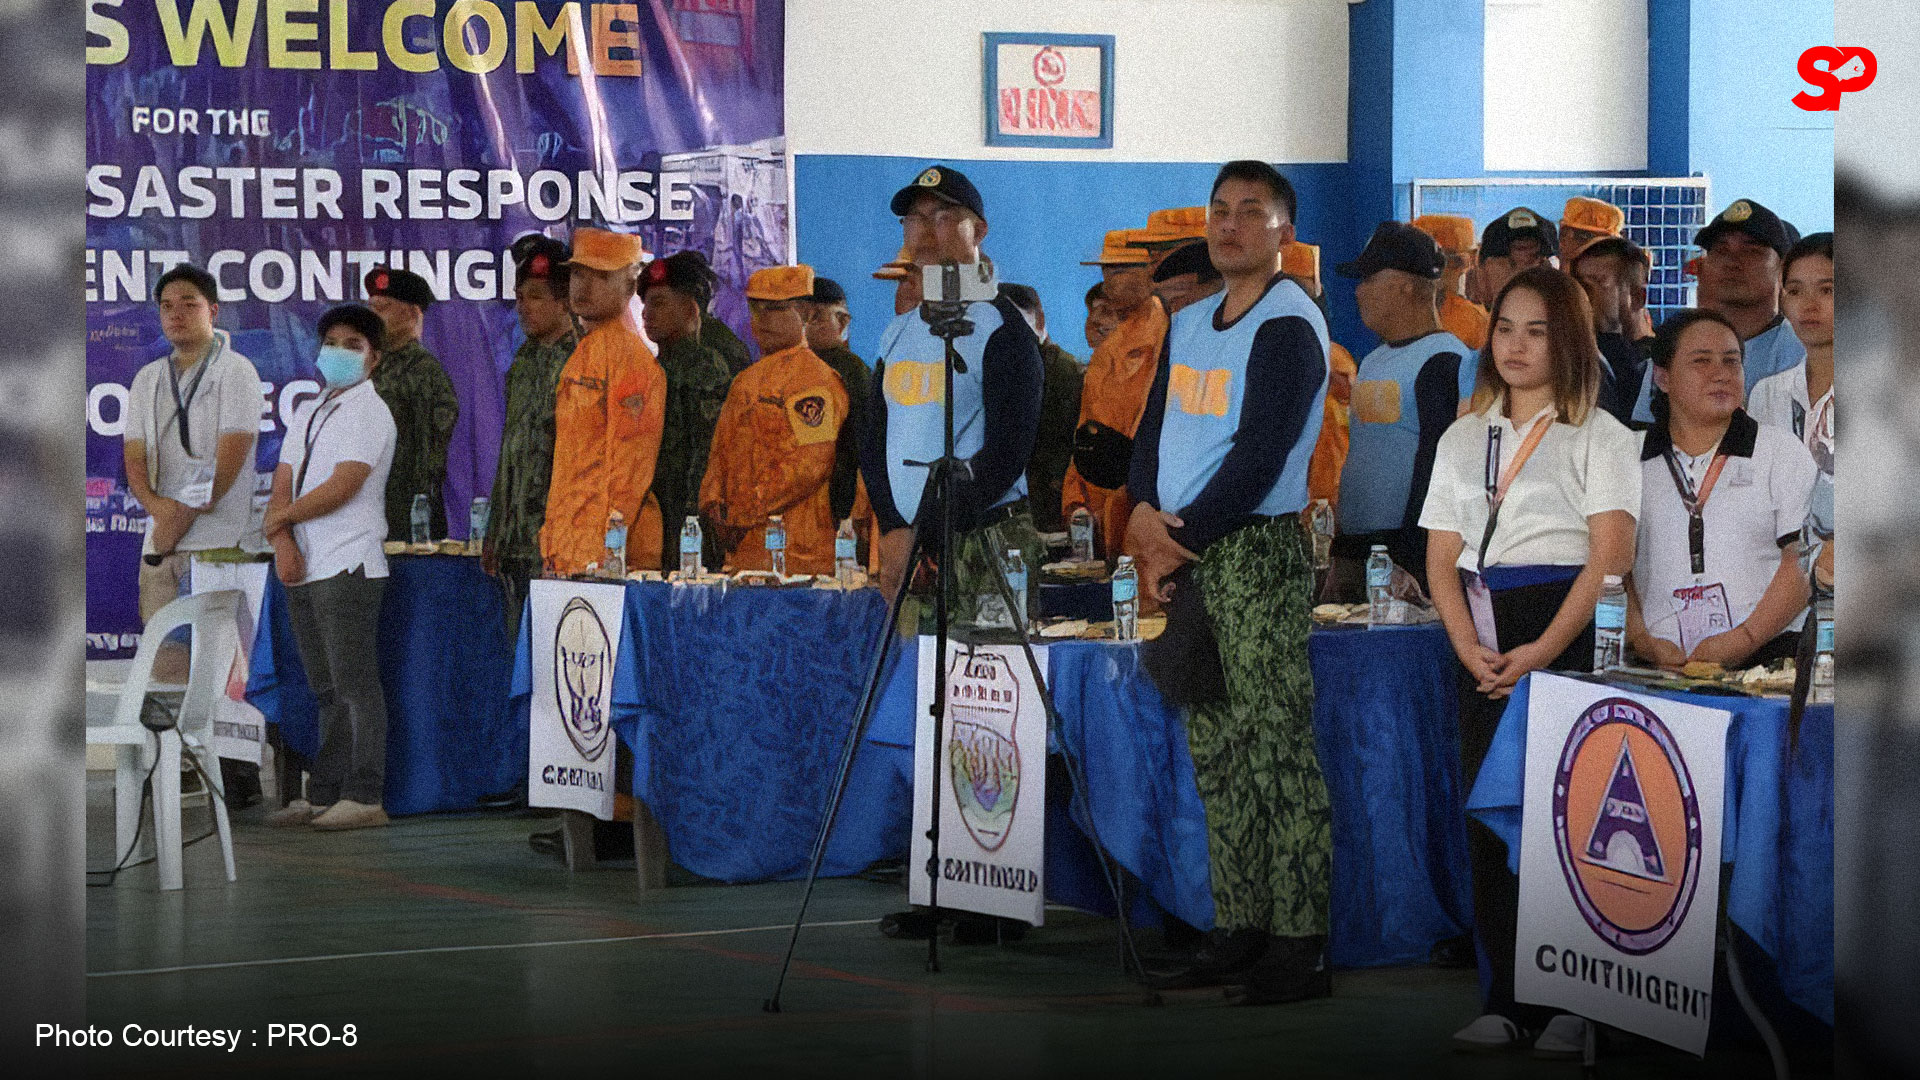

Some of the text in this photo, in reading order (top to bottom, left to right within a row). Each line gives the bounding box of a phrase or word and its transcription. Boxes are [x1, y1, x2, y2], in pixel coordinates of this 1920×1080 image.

[155, 0, 641, 77] WELCOME
[132, 106, 200, 134] FOR
[361, 168, 694, 221] RESPONSE
